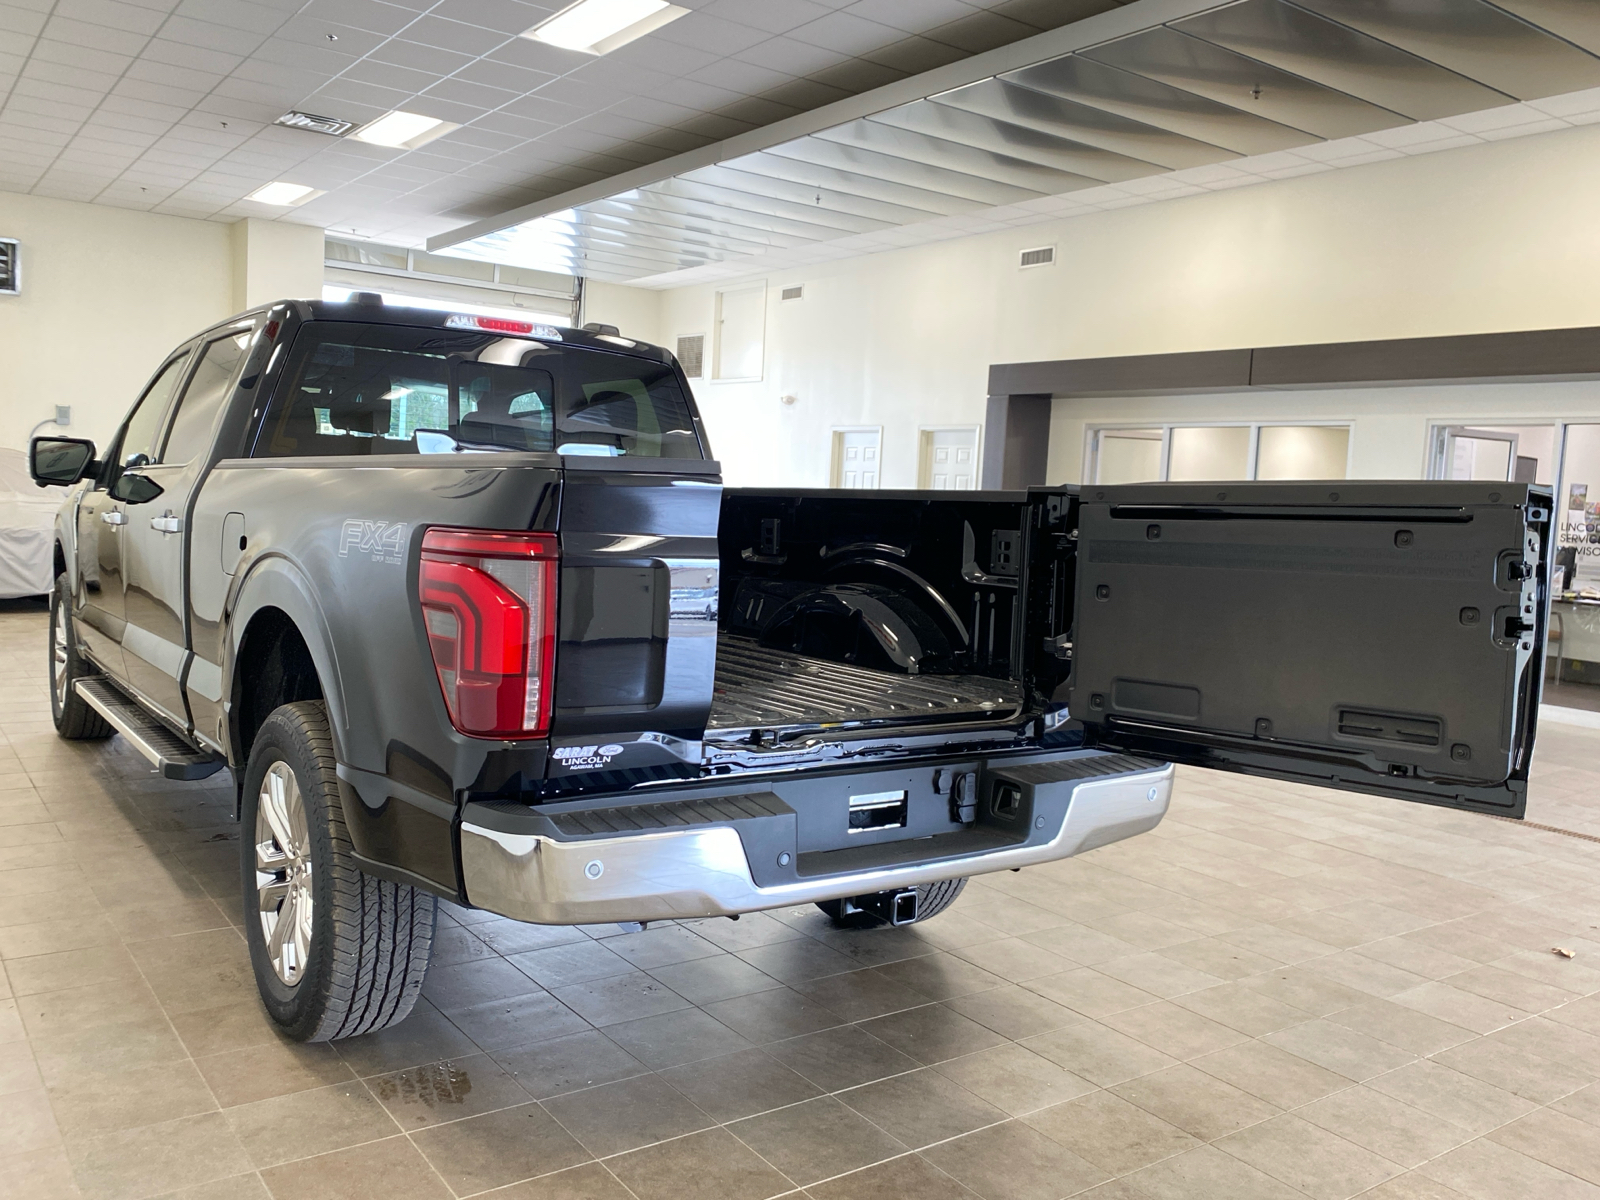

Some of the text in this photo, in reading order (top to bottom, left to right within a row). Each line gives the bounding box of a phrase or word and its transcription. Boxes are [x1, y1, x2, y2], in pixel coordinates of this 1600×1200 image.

[338, 518, 408, 557] FX4
[552, 746, 598, 759] SARAT
[562, 756, 611, 765] LINCOLN
